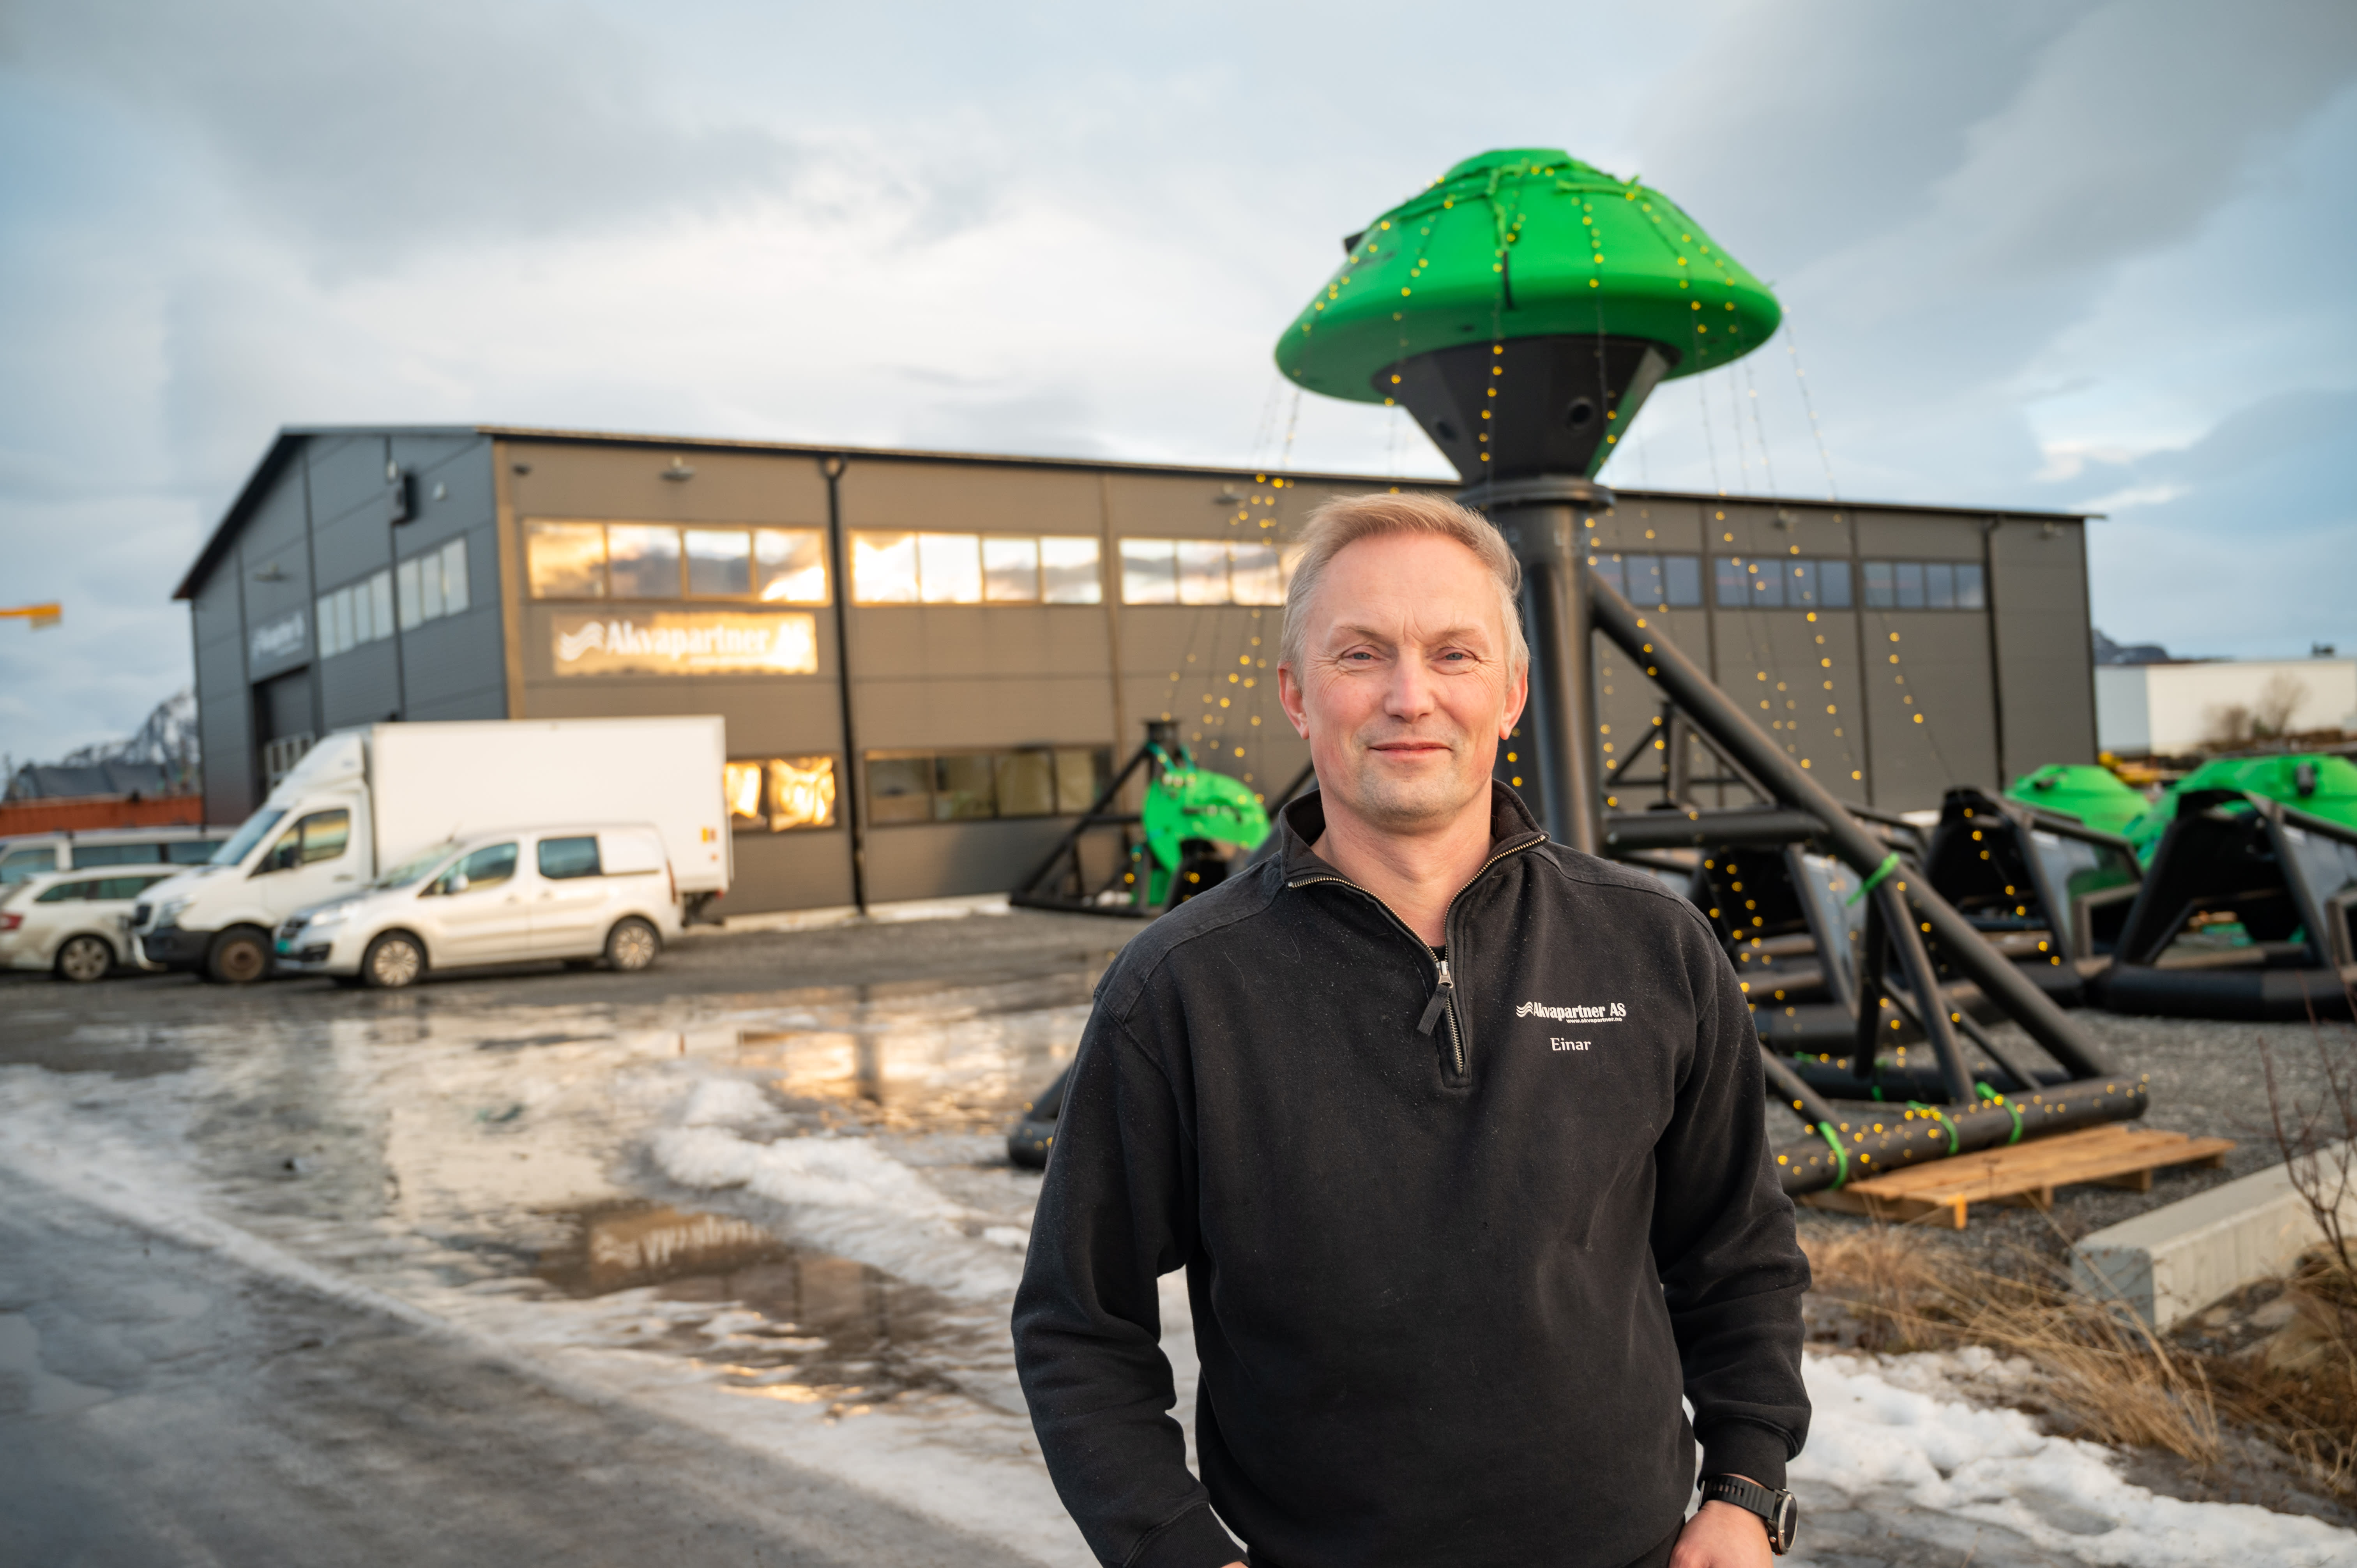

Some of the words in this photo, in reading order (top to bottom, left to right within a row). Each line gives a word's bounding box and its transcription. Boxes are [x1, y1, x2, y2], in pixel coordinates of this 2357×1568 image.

[606, 621, 770, 660] Akvapartner
[1533, 1002, 1606, 1021] Akvapartner
[1610, 1003, 1627, 1017] AS
[1550, 1037, 1591, 1051] Einar
